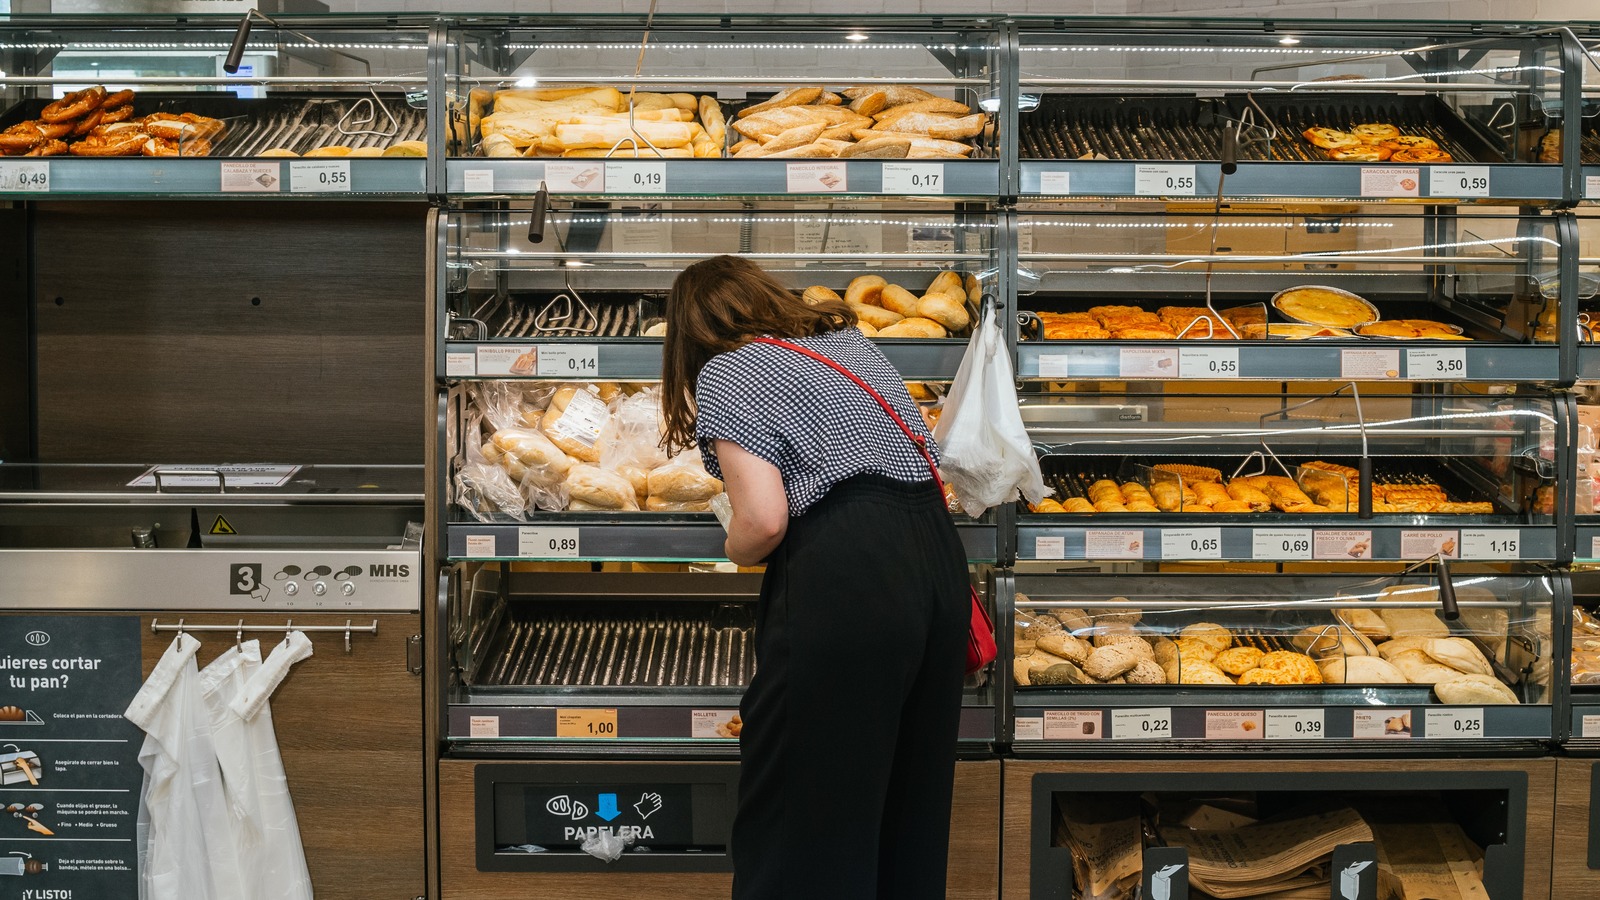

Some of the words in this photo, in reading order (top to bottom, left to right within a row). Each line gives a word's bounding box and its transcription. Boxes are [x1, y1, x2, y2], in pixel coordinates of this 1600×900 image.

[20, 173, 46, 185] 0,49
[320, 172, 346, 185] 0,55
[634, 173, 661, 185] 0,19
[912, 174, 939, 187] 0,17
[1166, 177, 1193, 190] 0,55
[1460, 178, 1486, 190] 0,59
[568, 358, 595, 371] 0,14
[1209, 361, 1236, 373] 0,55
[1436, 360, 1463, 372] 3,50
[549, 539, 576, 551] 0,89
[1191, 540, 1217, 552] 0,65
[1282, 540, 1308, 553] 0,69
[1490, 541, 1516, 553] 1,15
[370, 564, 409, 577] MHS
[237, 566, 254, 591] 3
[52, 657, 101, 670] cortar
[10, 675, 25, 688] tu
[31, 674, 69, 691] pan?
[587, 722, 613, 735] 1,00
[1142, 720, 1168, 732] 0,22
[1295, 721, 1321, 734] 0,39
[1454, 720, 1480, 732] 0,25
[22, 890, 33, 900] ¡Y
[36, 890, 72, 899] LISTO!
